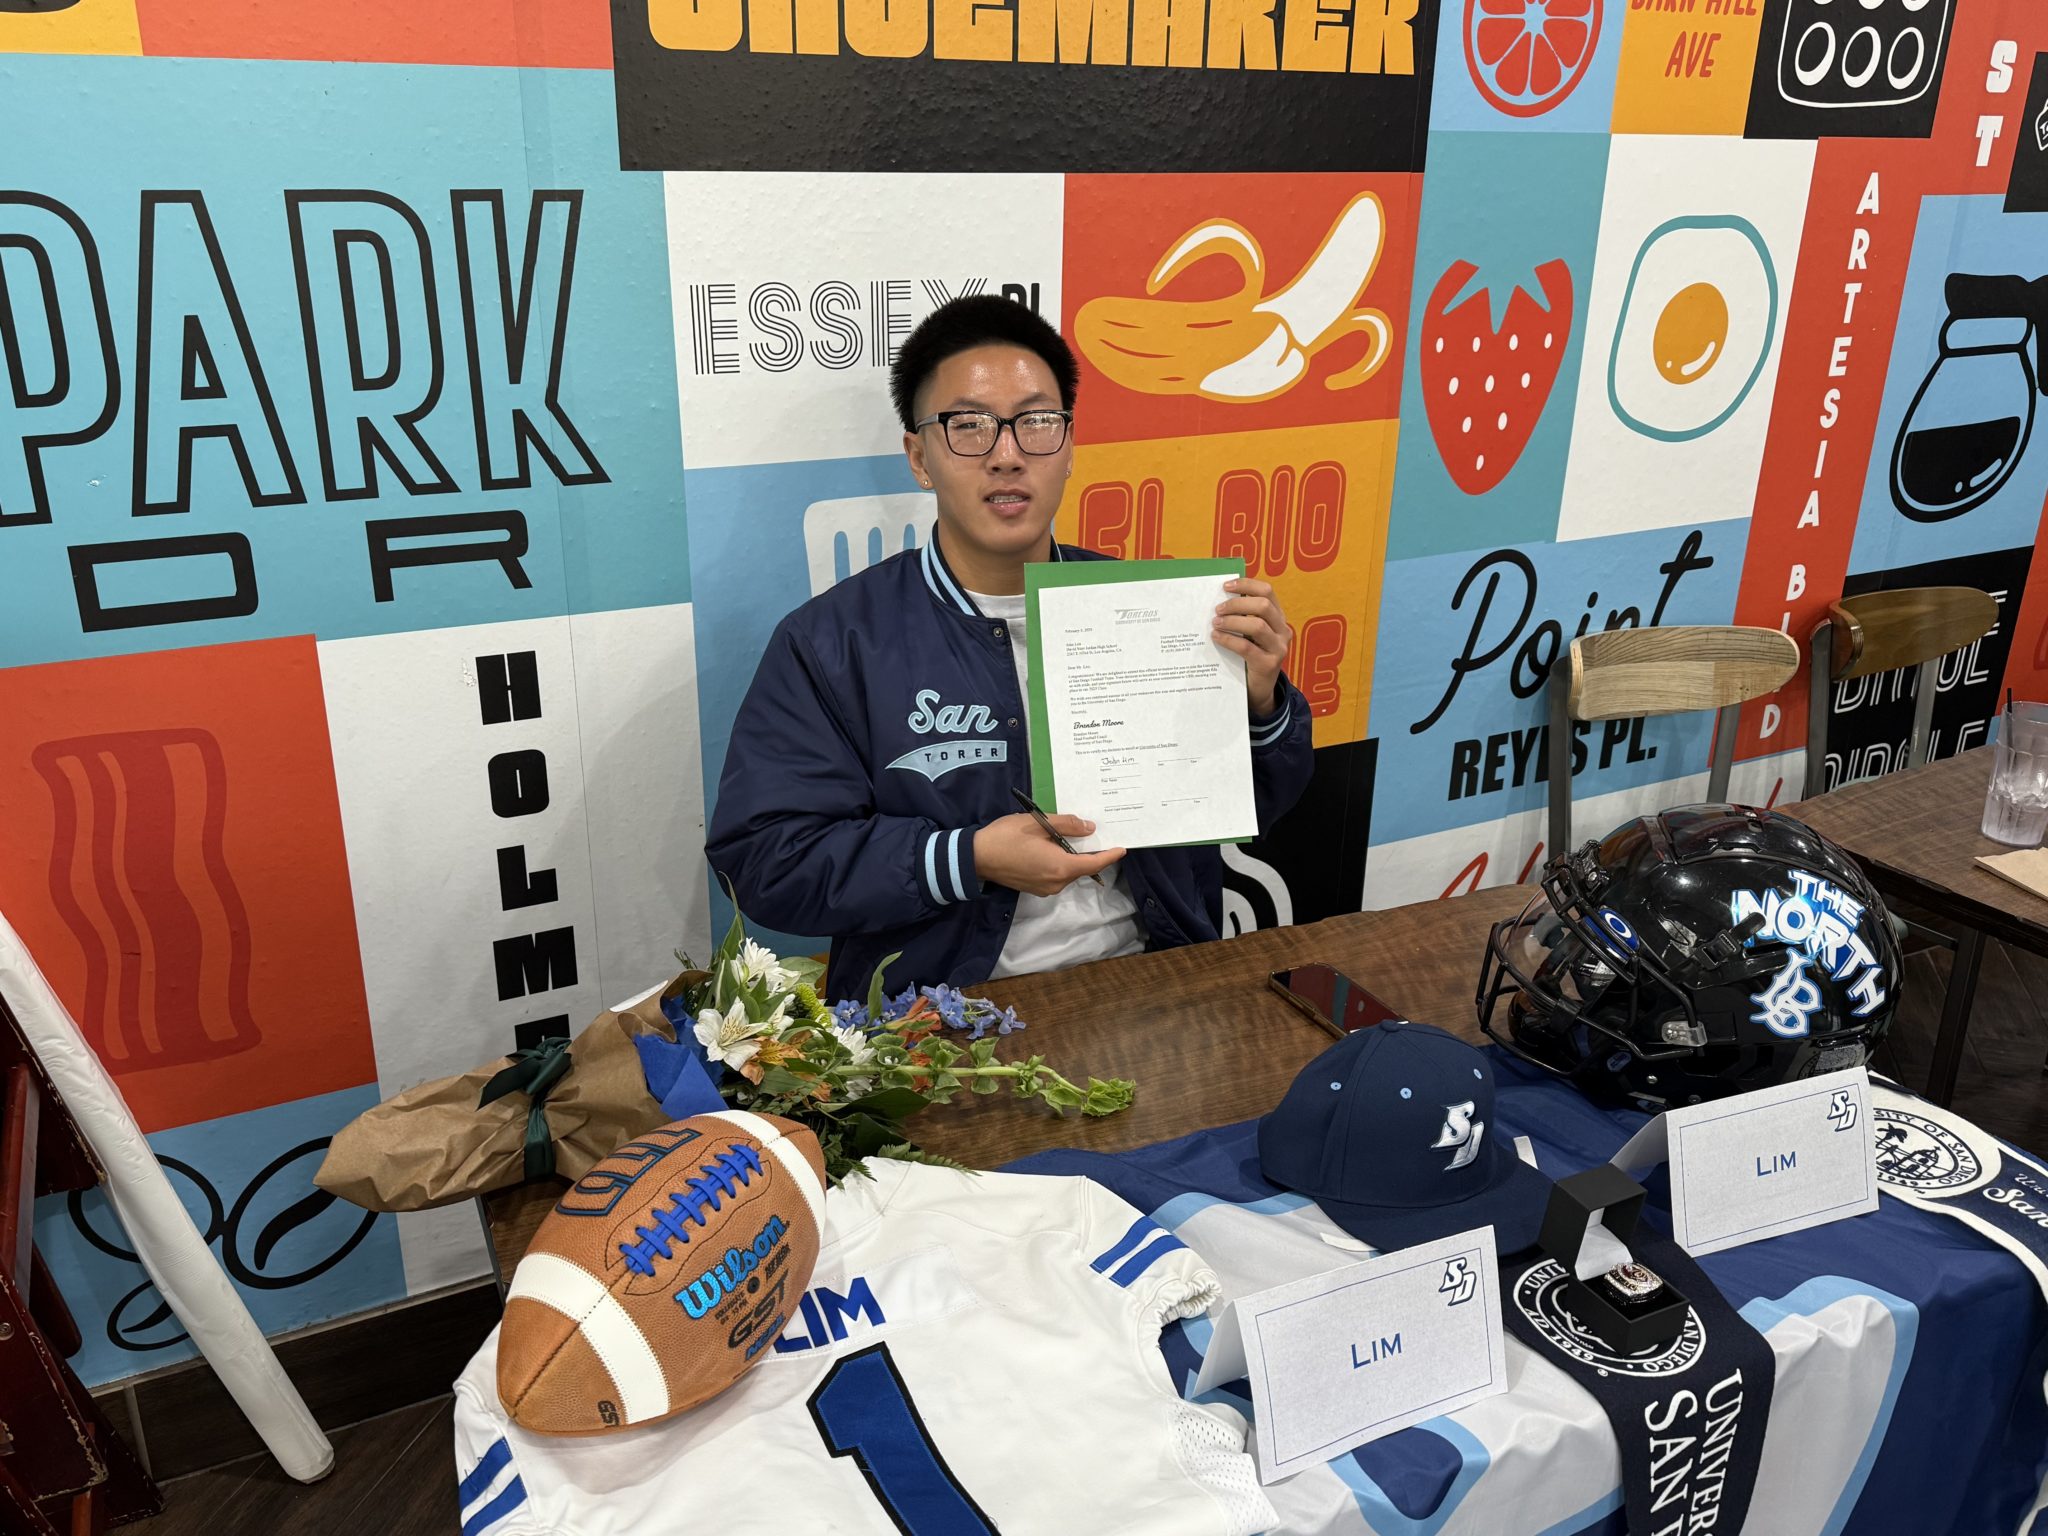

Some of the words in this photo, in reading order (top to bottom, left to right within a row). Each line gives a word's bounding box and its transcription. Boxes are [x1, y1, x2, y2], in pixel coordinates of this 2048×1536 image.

[1665, 31, 1721, 78] AVE
[0, 189, 612, 528] PARK
[1797, 172, 1880, 529] ARTESIA
[907, 689, 999, 734] San
[1788, 870, 1866, 930] THE
[674, 1214, 788, 1319] Wilson
[1687, 1368, 1743, 1536] UNIVER
